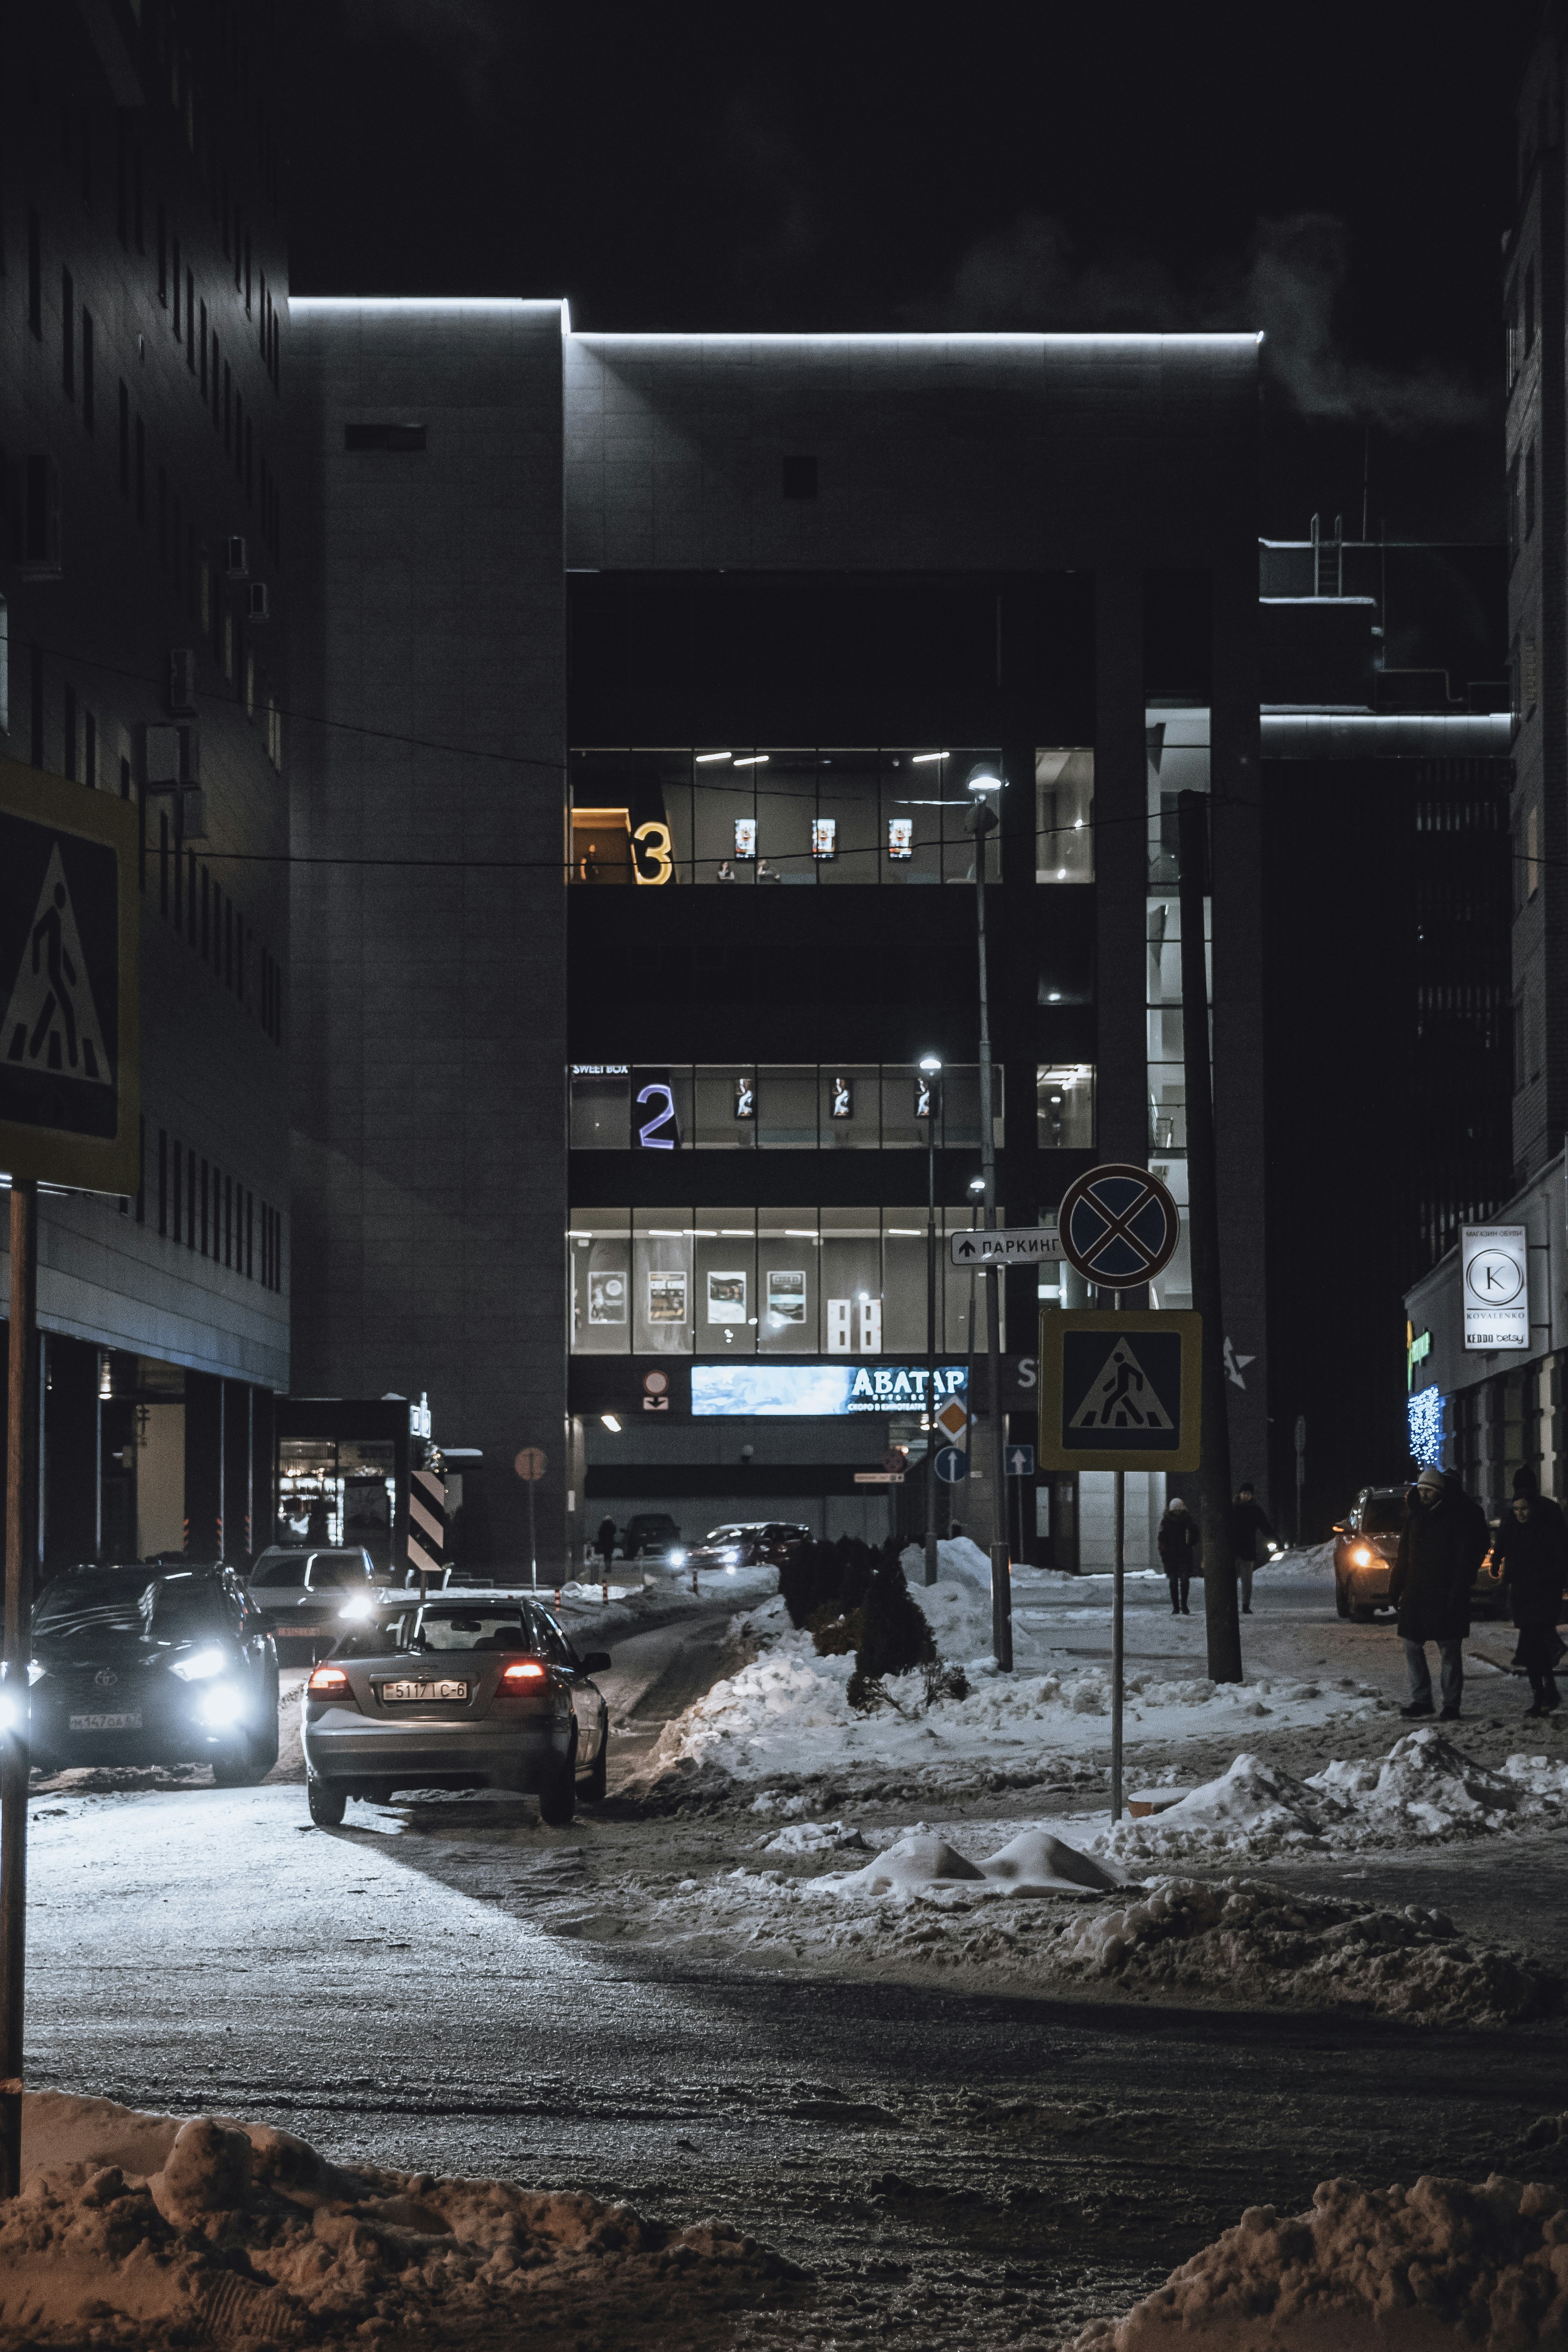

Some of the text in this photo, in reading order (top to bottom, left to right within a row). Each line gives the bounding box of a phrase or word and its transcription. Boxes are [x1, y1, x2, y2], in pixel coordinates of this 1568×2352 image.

[633, 820, 672, 885] 3
[636, 1083, 675, 1150] 2
[982, 1239, 1058, 1254] ПАРКИНГ
[1484, 1266, 1506, 1290] K
[852, 1368, 964, 1396] АВАТАР
